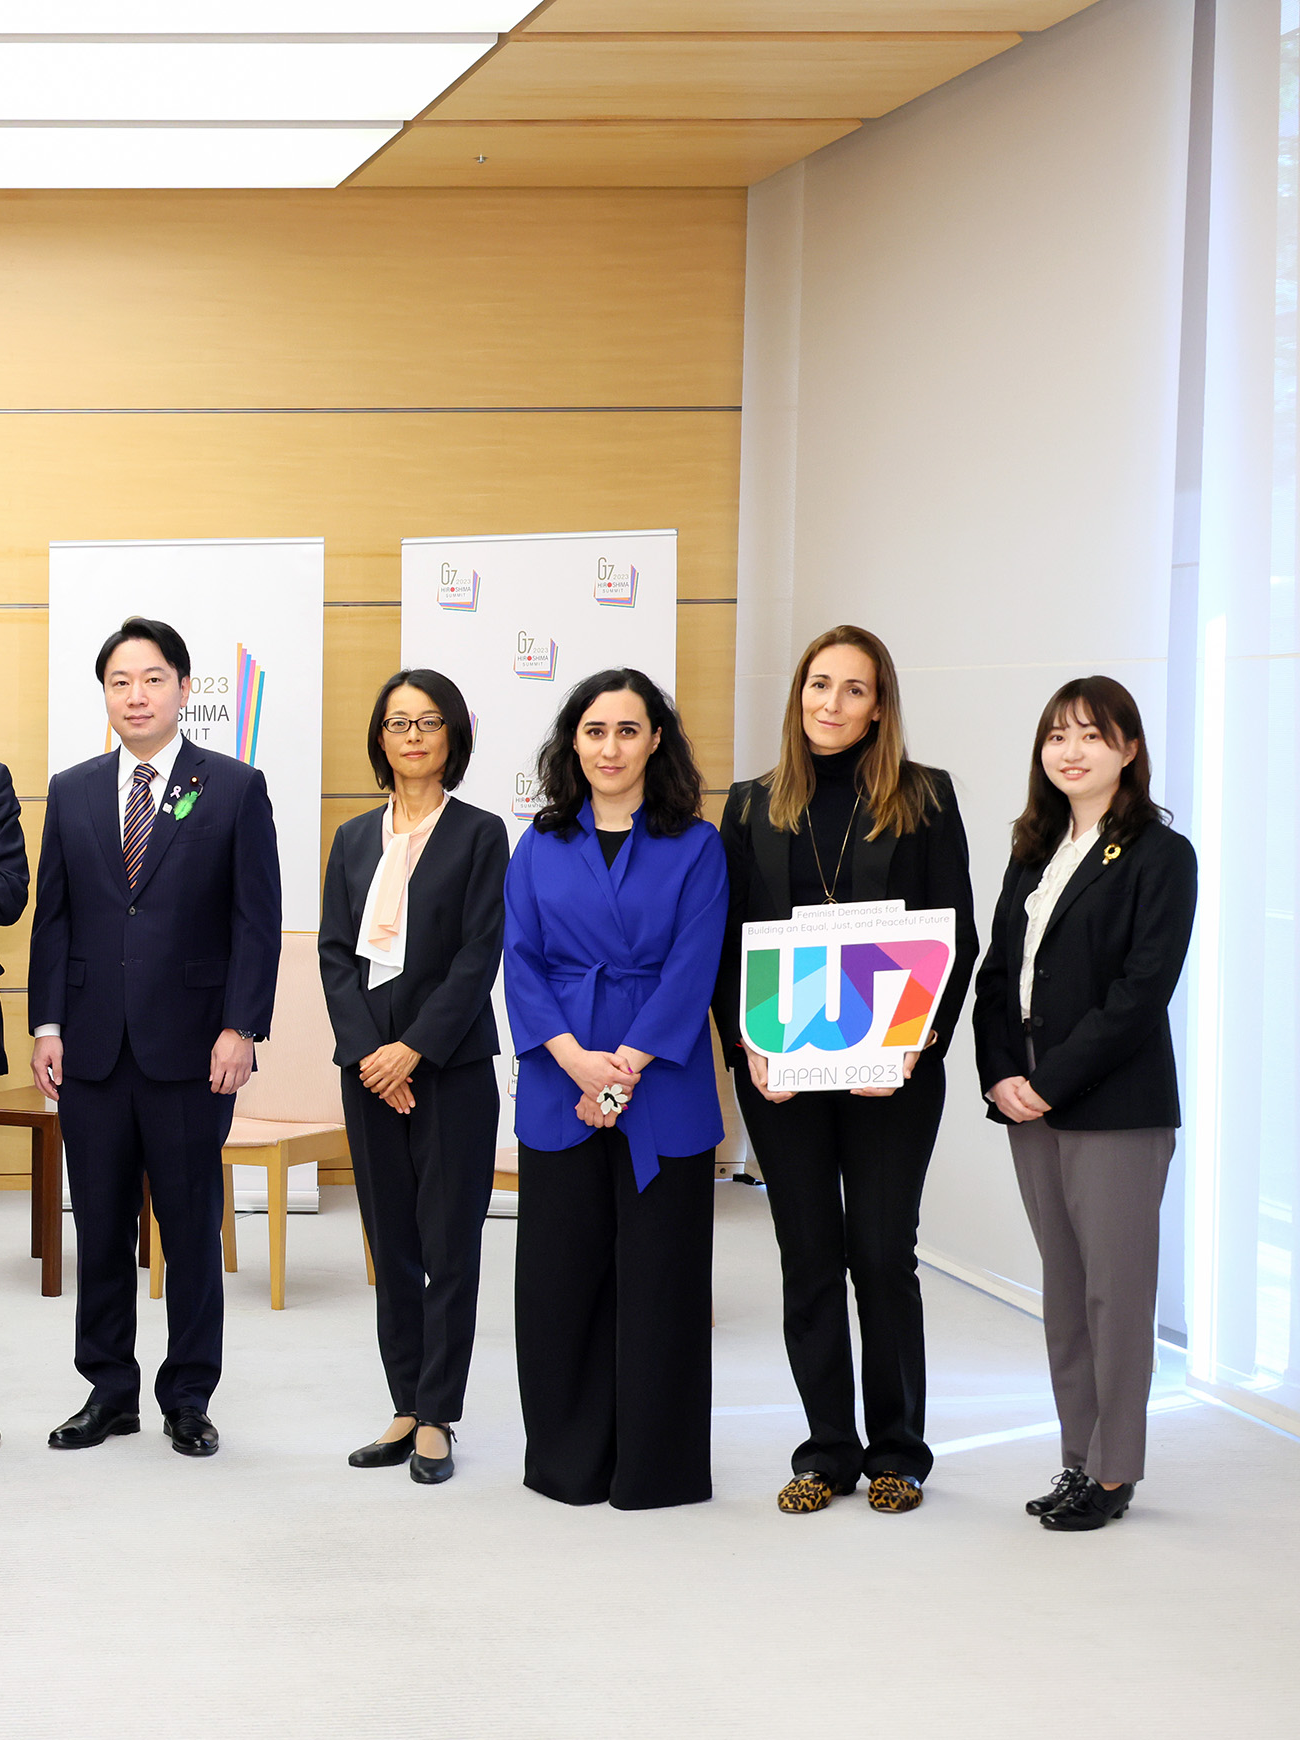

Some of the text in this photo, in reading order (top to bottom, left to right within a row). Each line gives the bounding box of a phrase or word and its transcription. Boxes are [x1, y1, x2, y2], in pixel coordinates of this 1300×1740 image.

[441, 562, 458, 586] G7
[597, 557, 615, 581] G7
[517, 630, 534, 654] G7
[191, 676, 229, 694] 023
[178, 704, 230, 722] SHIMA
[180, 728, 210, 741] MIT
[516, 772, 533, 796] G7
[797, 904, 899, 919] Feminist Demands for
[748, 925, 784, 936] Building
[801, 922, 829, 933] Equal,
[831, 921, 853, 930] Just,
[855, 918, 873, 928] and
[876, 917, 916, 927] Peaceful
[919, 915, 950, 924] Future
[746, 939, 950, 1053] W7
[773, 1064, 898, 1087] JAPAN 2023
